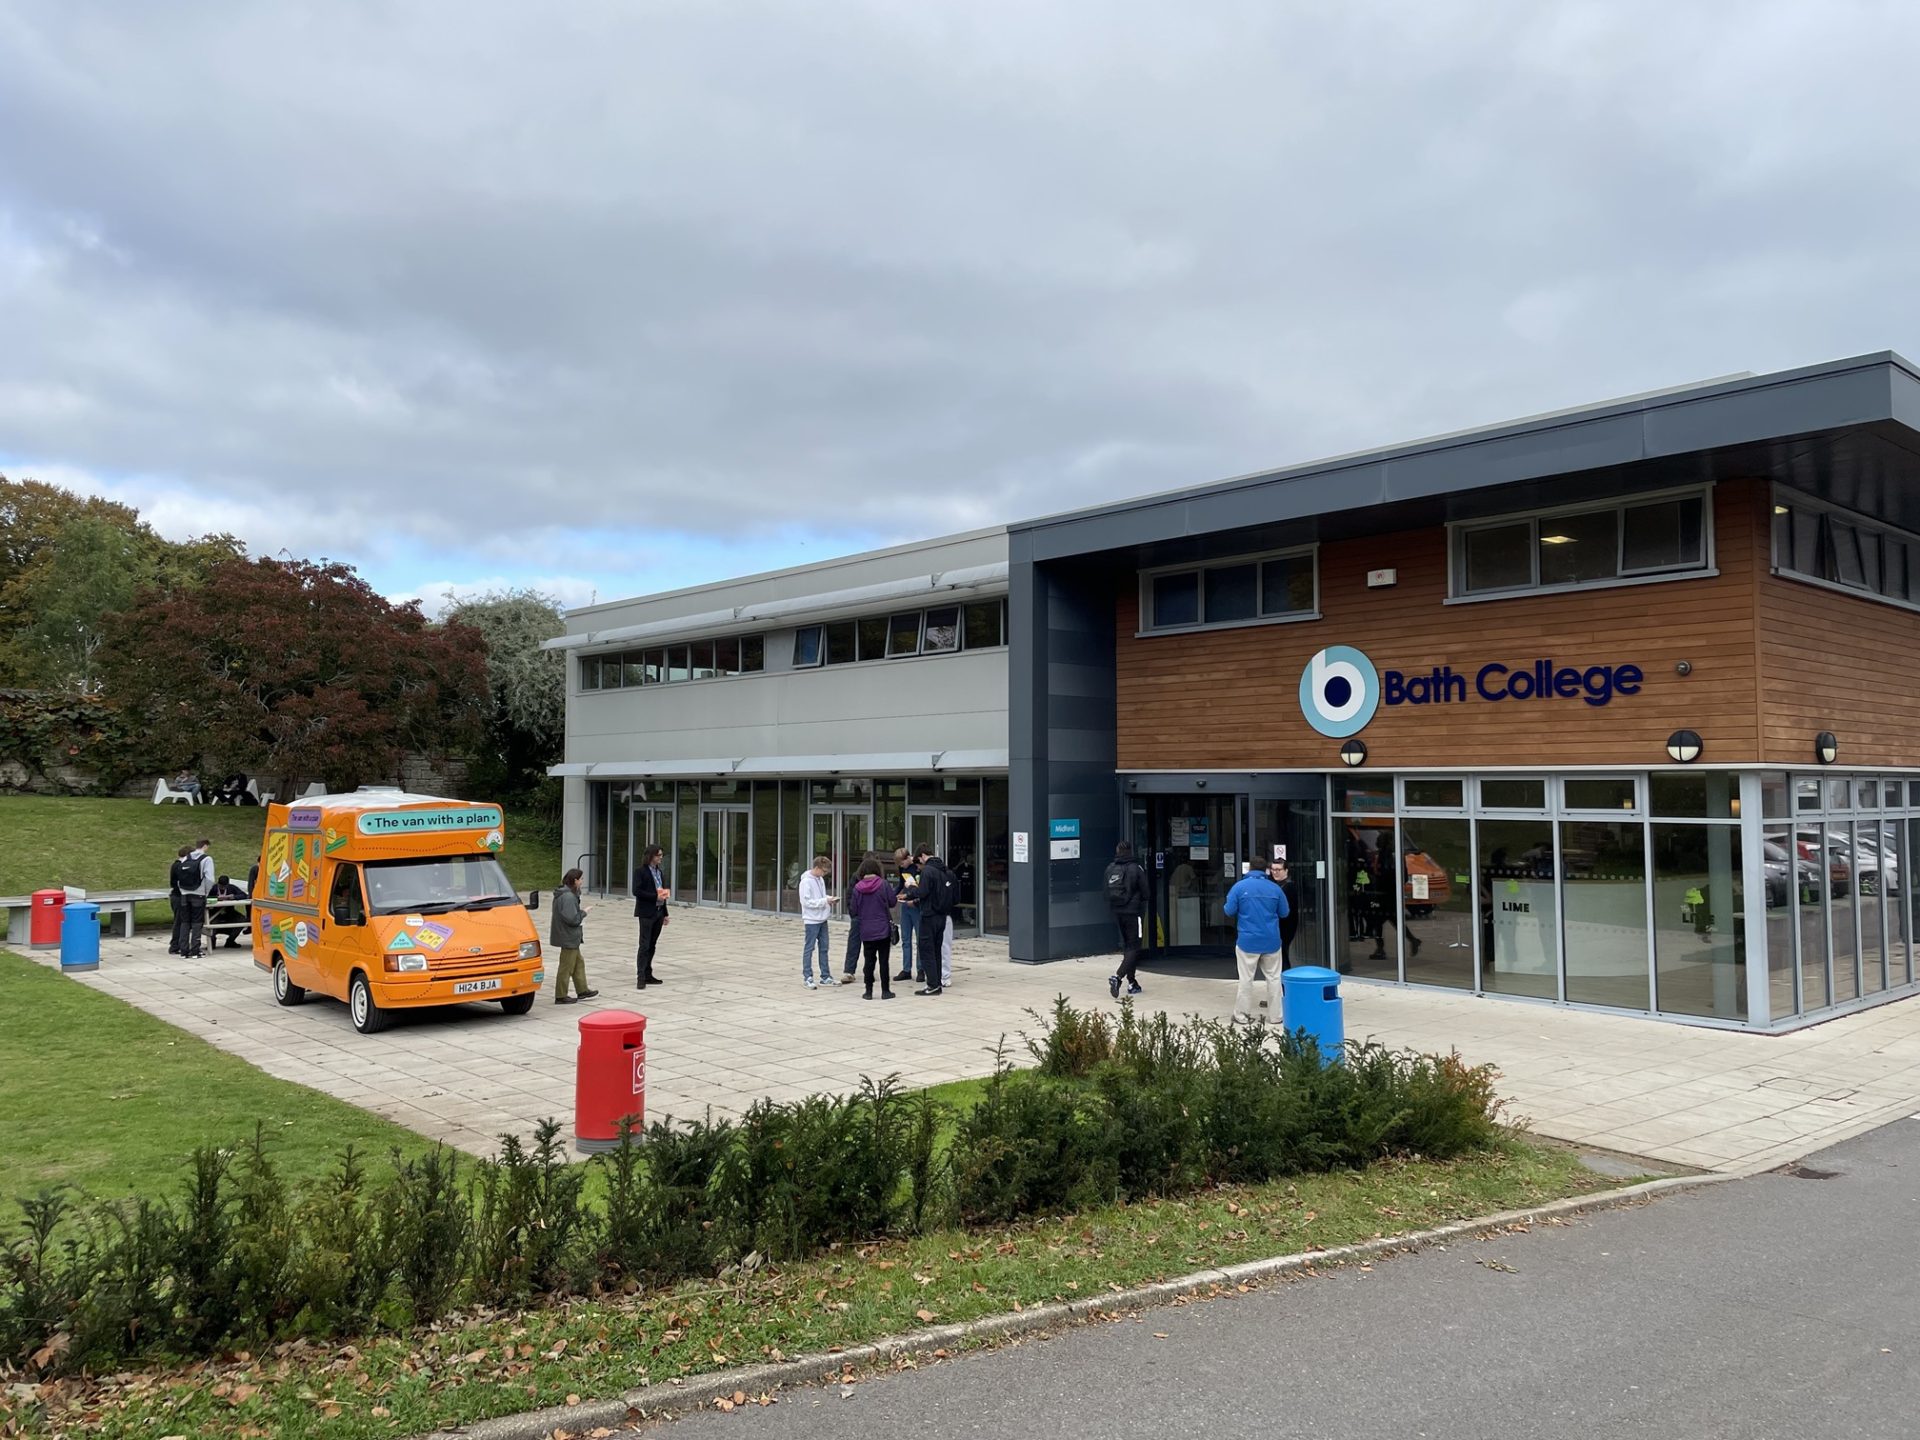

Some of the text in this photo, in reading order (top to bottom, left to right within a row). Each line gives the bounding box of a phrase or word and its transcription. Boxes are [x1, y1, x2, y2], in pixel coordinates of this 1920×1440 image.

[1384, 659, 1644, 707] Bath College
[374, 813, 490, 828] The van with a plan
[1502, 901, 1530, 913] LIME
[458, 980, 497, 993] H124 BJA
